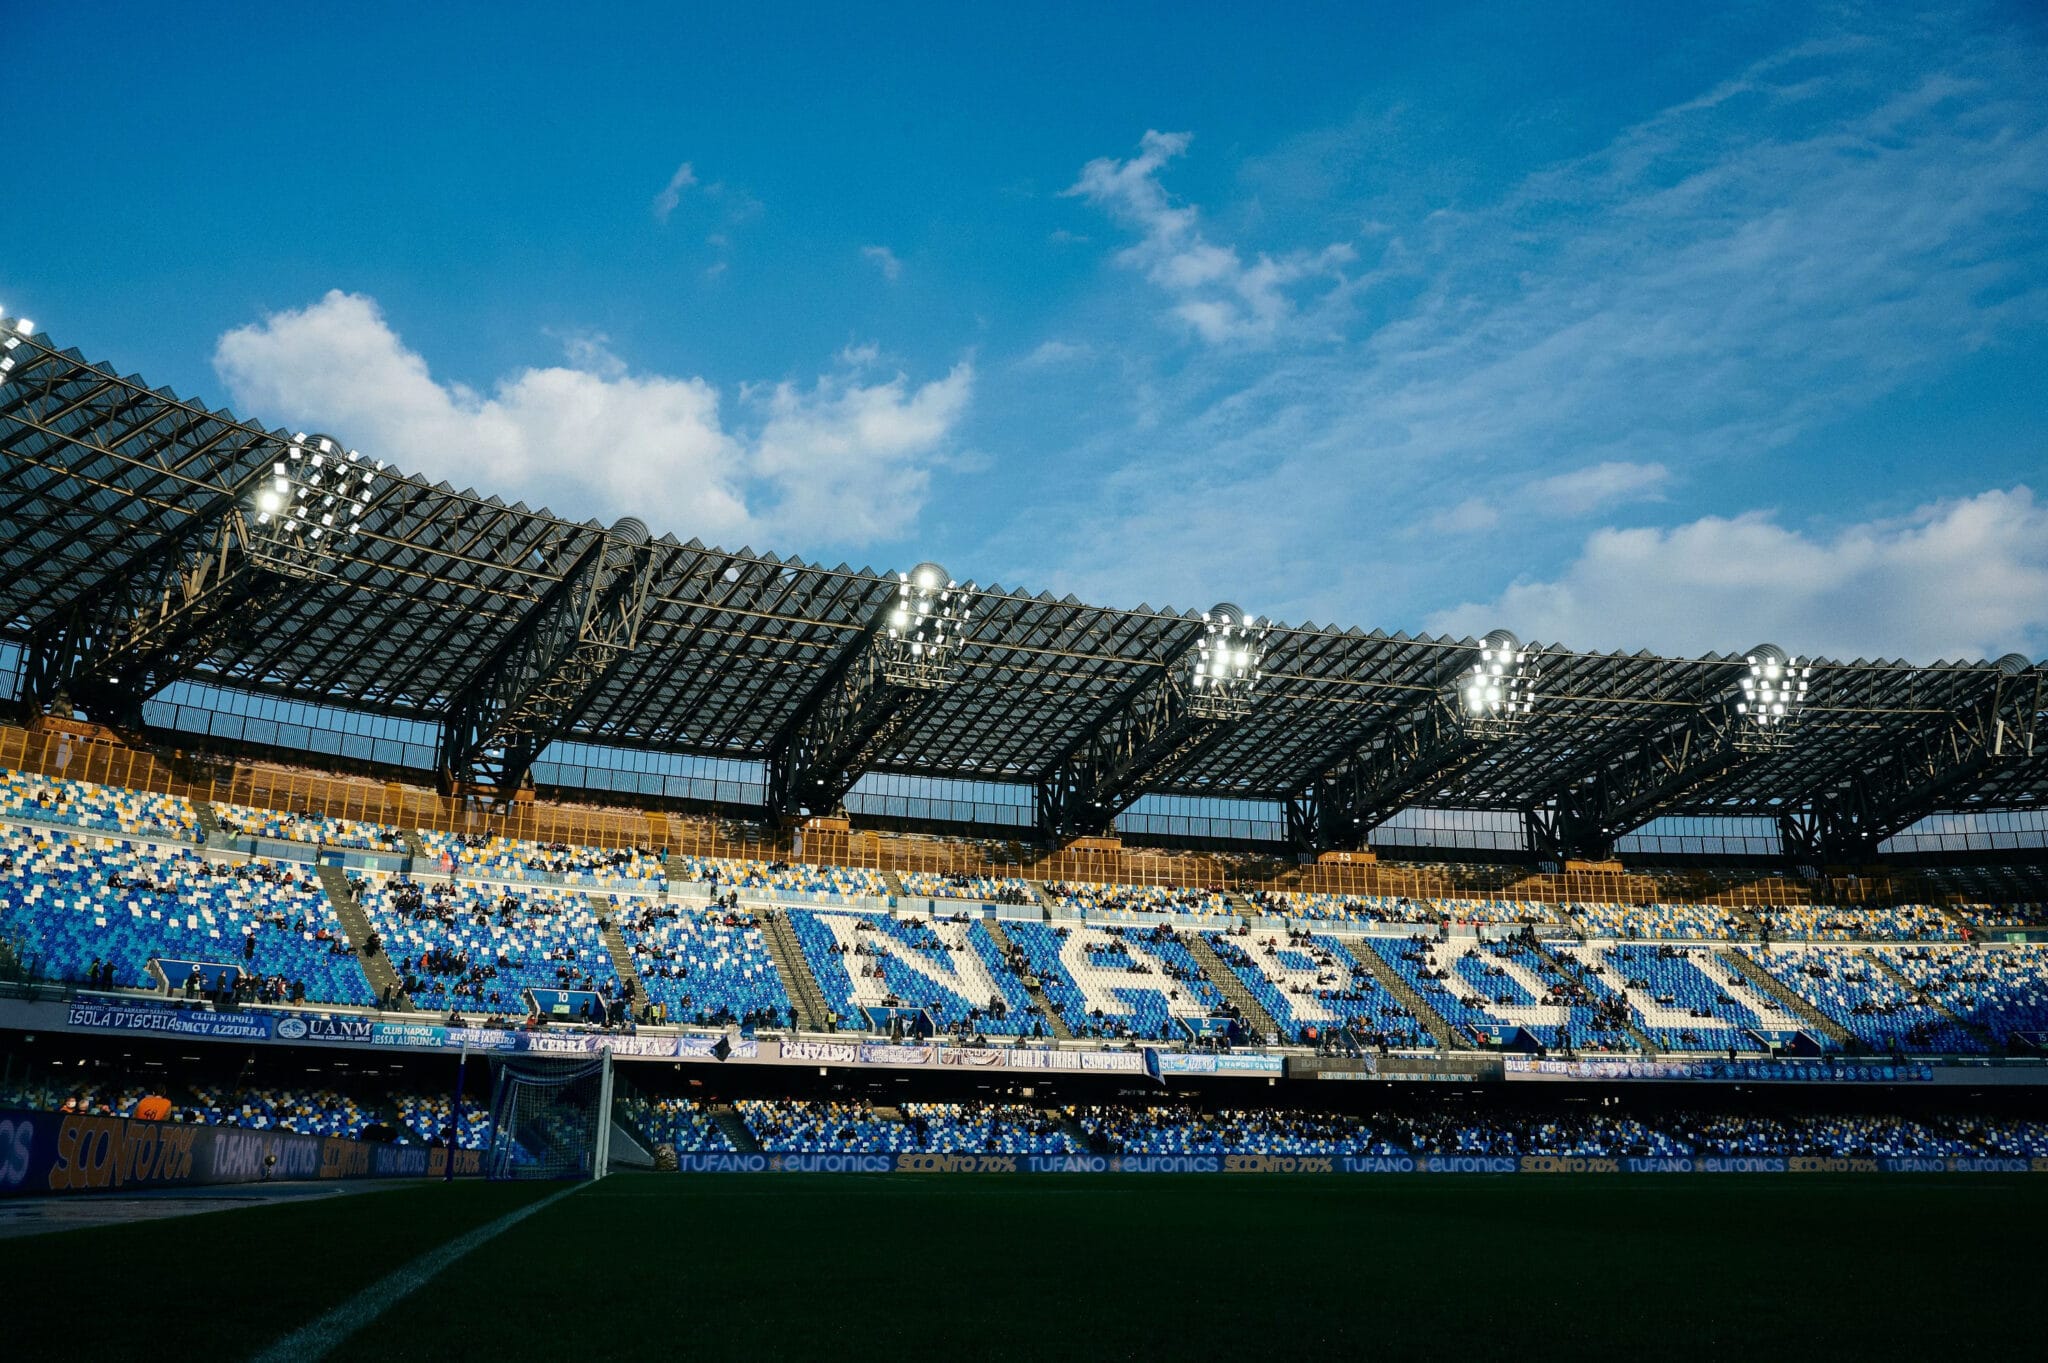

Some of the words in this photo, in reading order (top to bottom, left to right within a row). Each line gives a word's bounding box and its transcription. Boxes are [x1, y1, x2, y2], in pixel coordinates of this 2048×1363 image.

[813, 912, 1809, 1032] NAPOLI
[558, 992, 569, 1003] 10
[68, 1009, 111, 1026] ISOLA
[115, 1012, 176, 1031] D'ISCHIA
[191, 1012, 217, 1021] CLUB
[219, 1015, 254, 1025] NAPOLI
[1202, 1019, 1210, 1028] 12
[211, 1025, 266, 1037] AZZURRA
[382, 1026, 402, 1034] CLUB
[404, 1027, 433, 1037] NAPOLI
[397, 1035, 442, 1047] AURUNCA
[528, 1038, 588, 1053] ACERRA
[1506, 1061, 1530, 1071] BLUE
[1539, 1062, 1566, 1073] TIGER
[48, 1115, 156, 1190] SCONTO
[152, 1125, 197, 1180] 70%
[212, 1134, 263, 1176] TUFANO
[681, 1155, 765, 1172] TUFANO
[784, 1154, 890, 1172] euronics
[895, 1154, 977, 1172] SCONTO
[977, 1154, 1017, 1172] 70%
[1029, 1157, 1105, 1172] TUFANO
[1121, 1156, 1218, 1172] euronics
[1223, 1156, 1296, 1172] SCONTO
[1299, 1156, 1333, 1172] 70%
[1343, 1158, 1413, 1173] TUFANO
[1429, 1157, 1515, 1173] euronics
[1520, 1157, 1586, 1173] SCONTO
[1587, 1157, 1619, 1173] 70%
[1630, 1158, 1691, 1172] TUFANO
[1706, 1157, 1784, 1172] euronics
[1887, 1159, 1944, 1172] TUFANO
[1957, 1158, 2028, 1172] euronics
